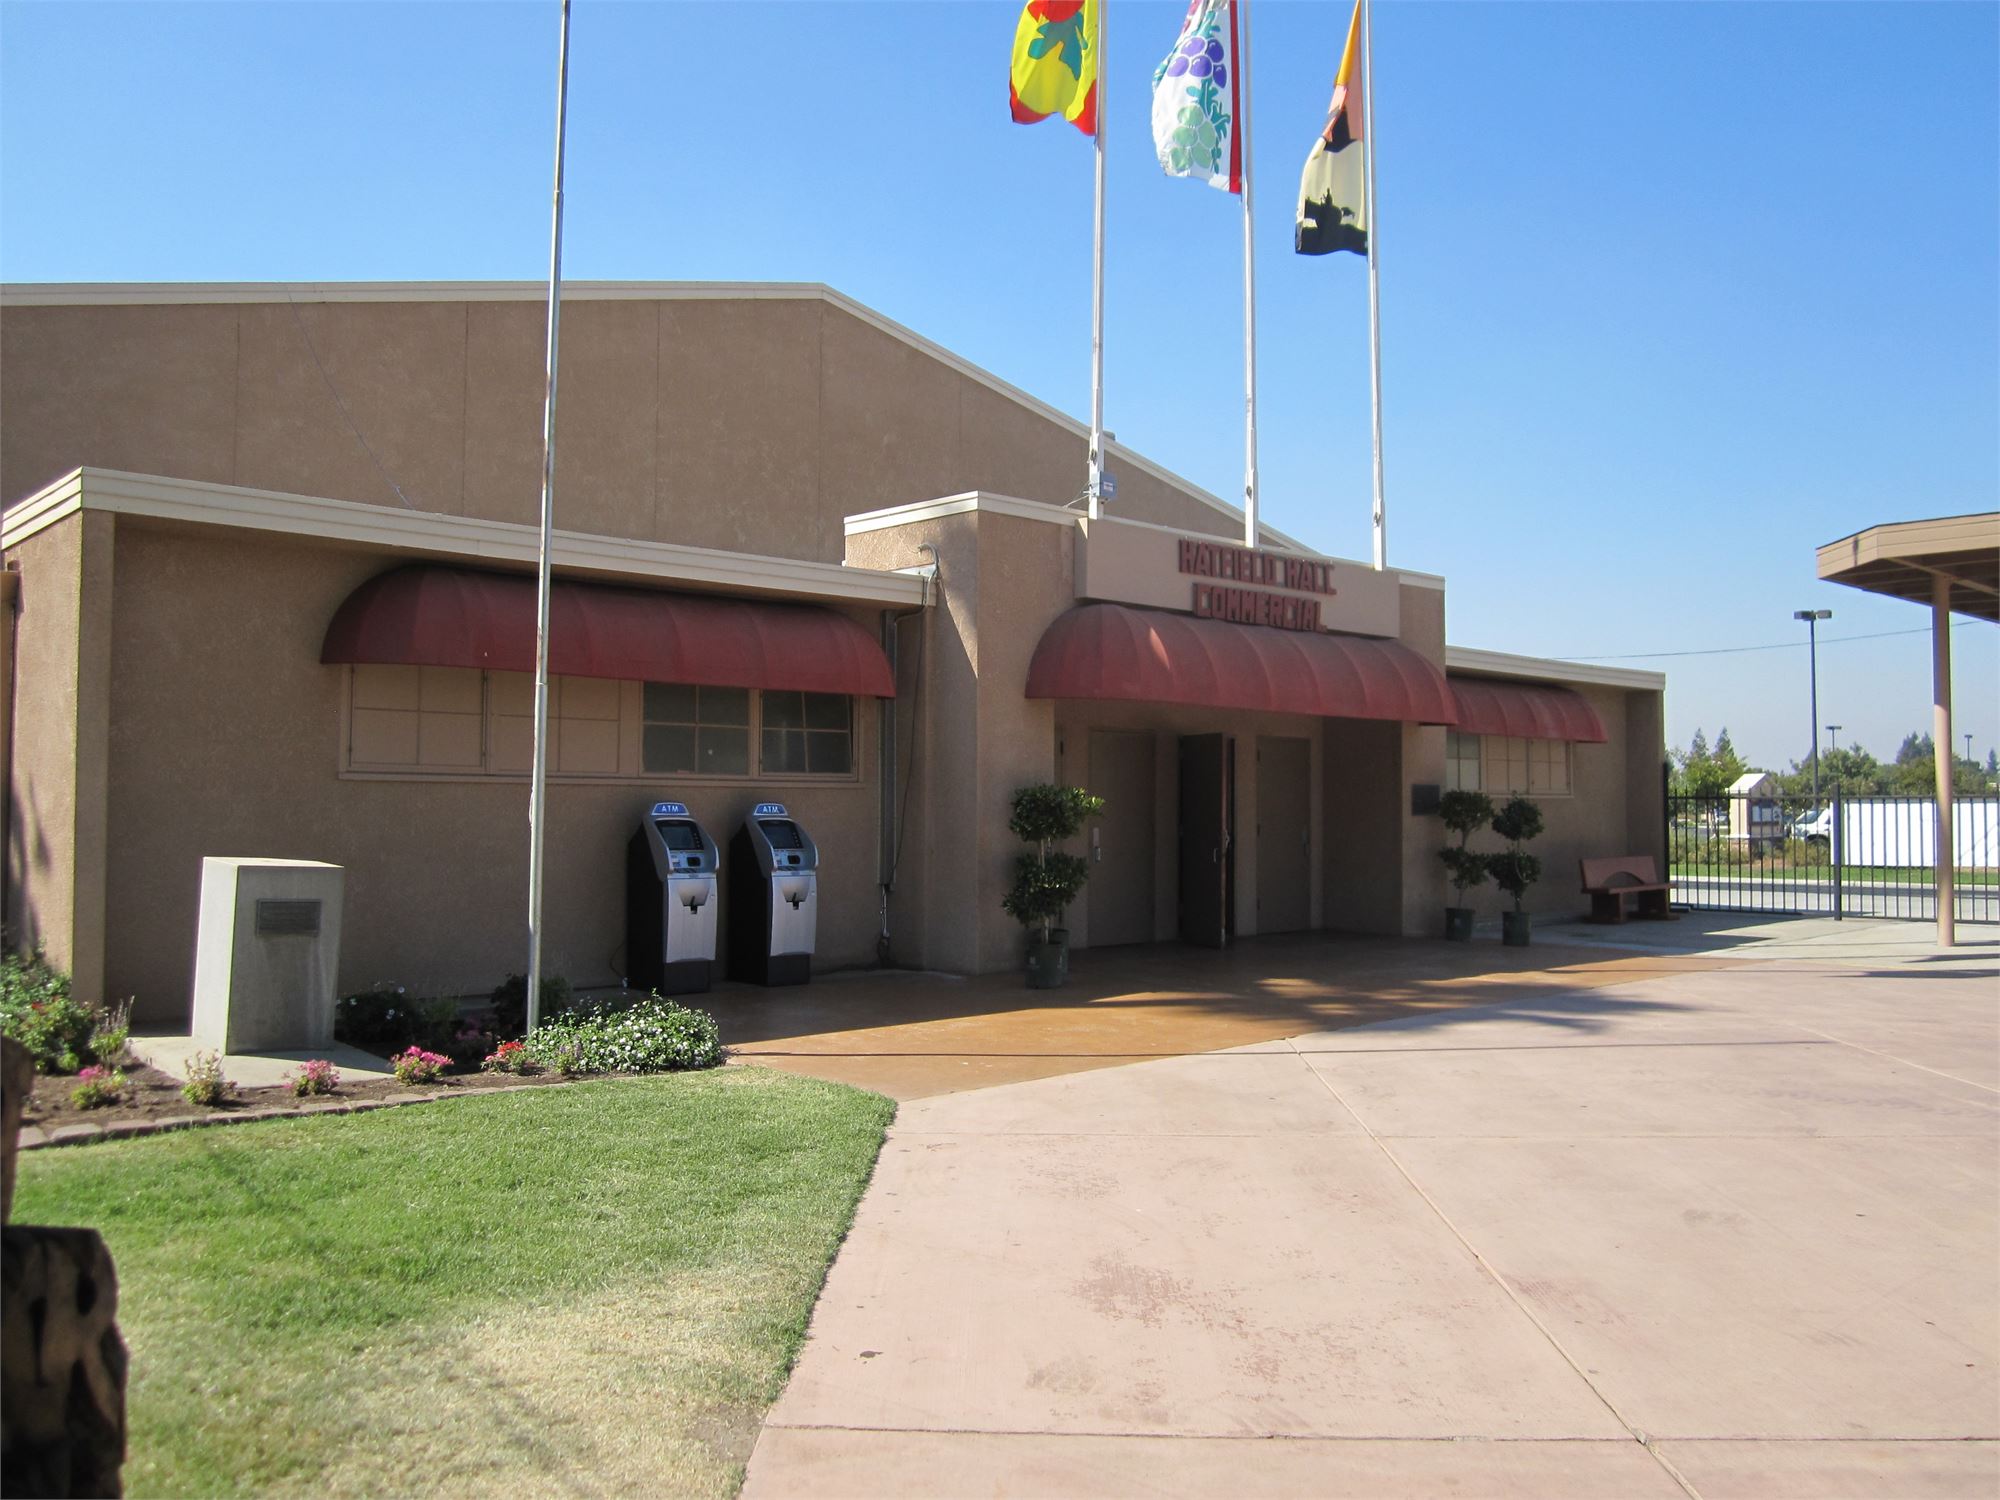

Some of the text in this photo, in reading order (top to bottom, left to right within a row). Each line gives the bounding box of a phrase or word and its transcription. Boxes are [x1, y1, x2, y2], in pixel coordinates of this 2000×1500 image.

[1179, 539, 1337, 595] HATFIELD HALL
[1193, 582, 1328, 633] COMMERCIAL
[762, 805, 779, 813] ATM
